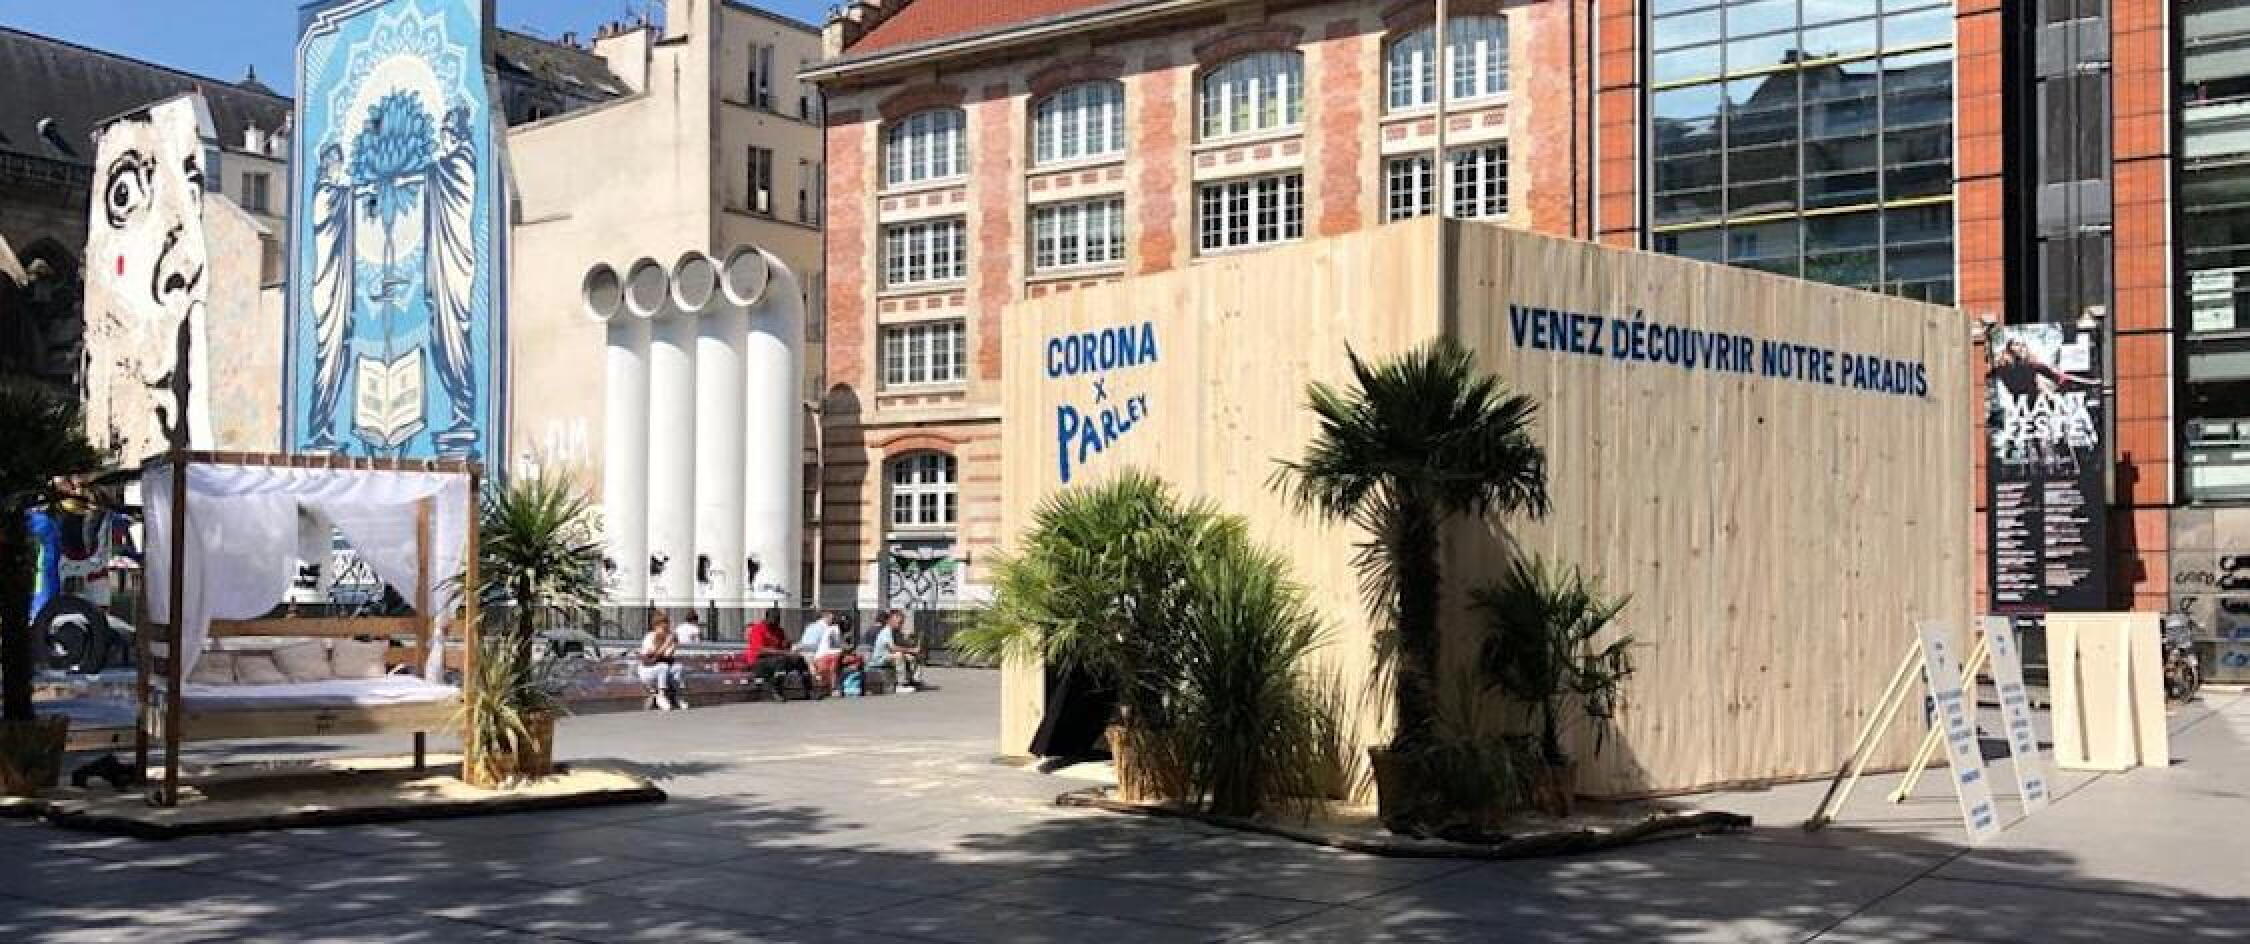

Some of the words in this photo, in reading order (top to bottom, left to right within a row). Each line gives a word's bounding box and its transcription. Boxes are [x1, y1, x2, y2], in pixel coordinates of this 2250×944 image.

[1048, 322, 1157, 378] CORONA
[1510, 304, 1604, 355] VENEZ
[1612, 310, 1753, 373] DÉCOUVRIR
[1762, 340, 1834, 384] NOTRE
[1841, 352, 1926, 397] PARADIS
